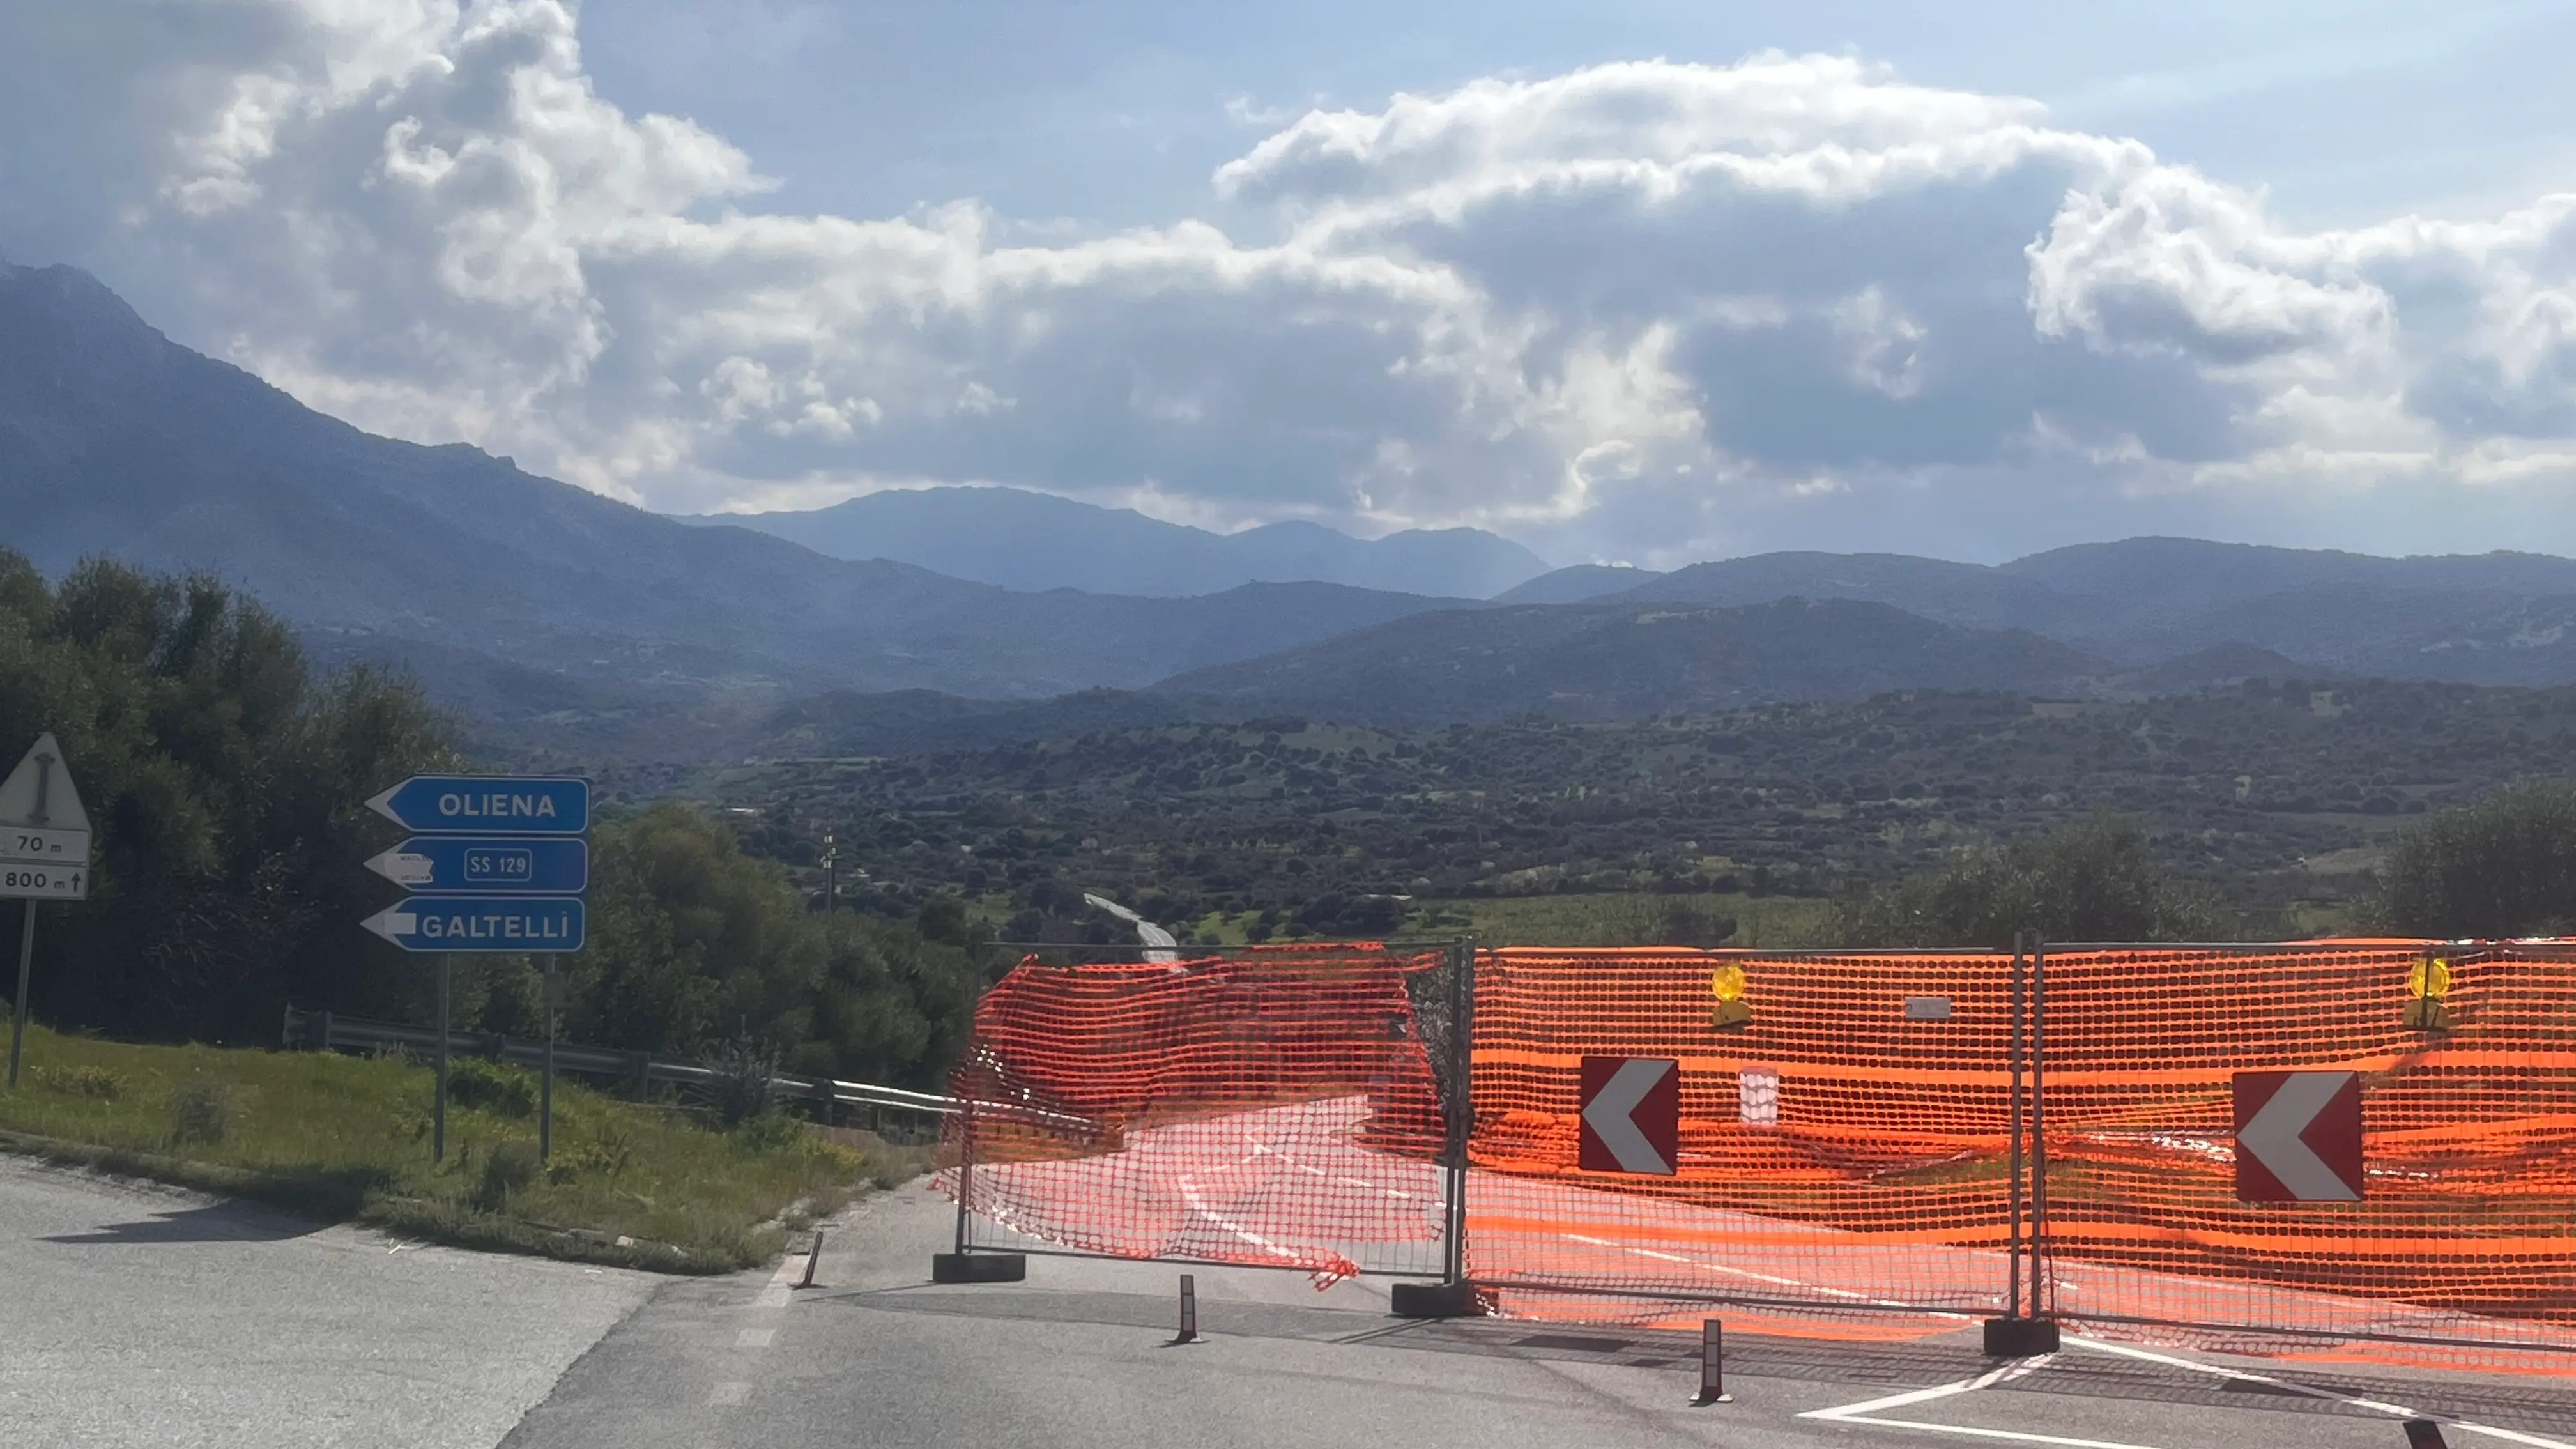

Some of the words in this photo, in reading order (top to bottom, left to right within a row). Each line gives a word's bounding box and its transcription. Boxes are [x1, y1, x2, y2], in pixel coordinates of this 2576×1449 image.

[439, 793, 556, 816] OLIENA
[17, 836, 43, 852] 70
[50, 844, 61, 853] m
[470, 857, 490, 873] SS
[499, 857, 526, 873] 129
[5, 872, 47, 888] 800
[54, 880, 65, 889] m
